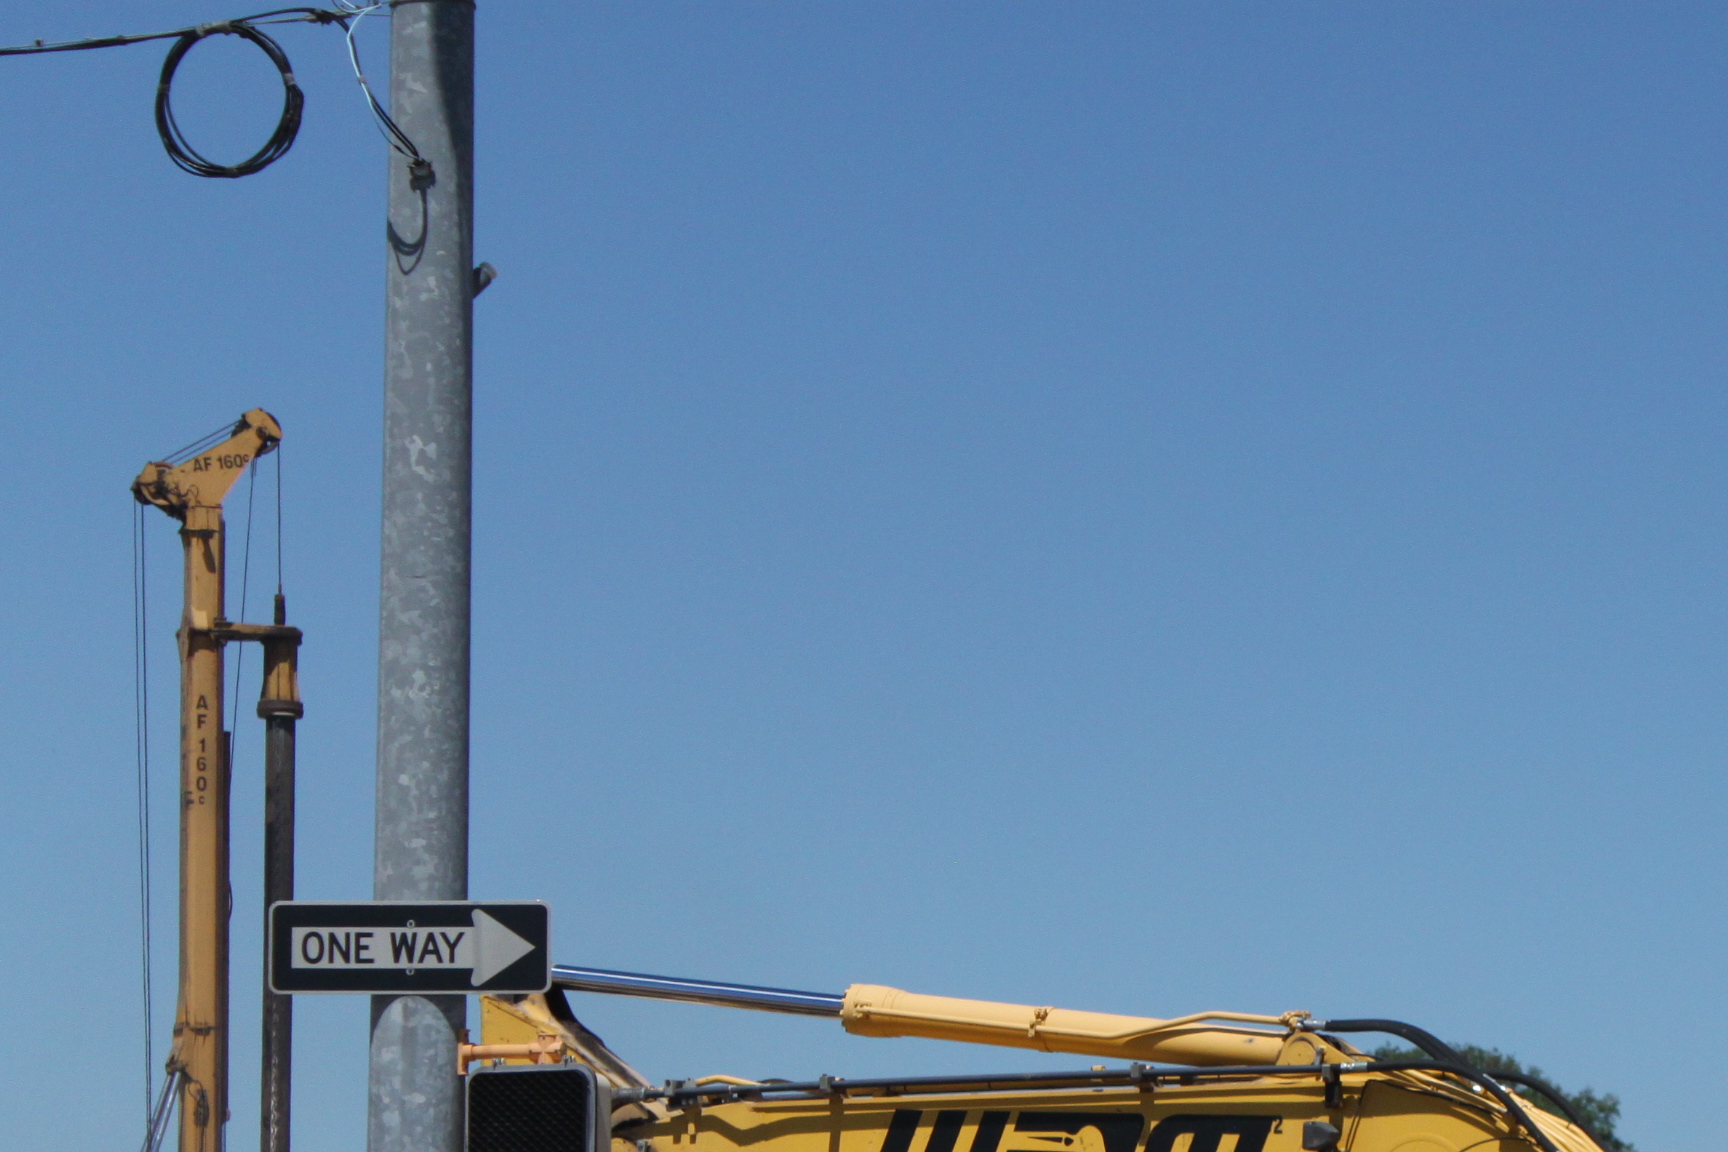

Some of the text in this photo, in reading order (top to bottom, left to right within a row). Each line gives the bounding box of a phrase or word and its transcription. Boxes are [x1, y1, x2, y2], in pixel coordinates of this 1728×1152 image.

[193, 456, 212, 472] AF
[301, 931, 465, 964] ONE WAY
